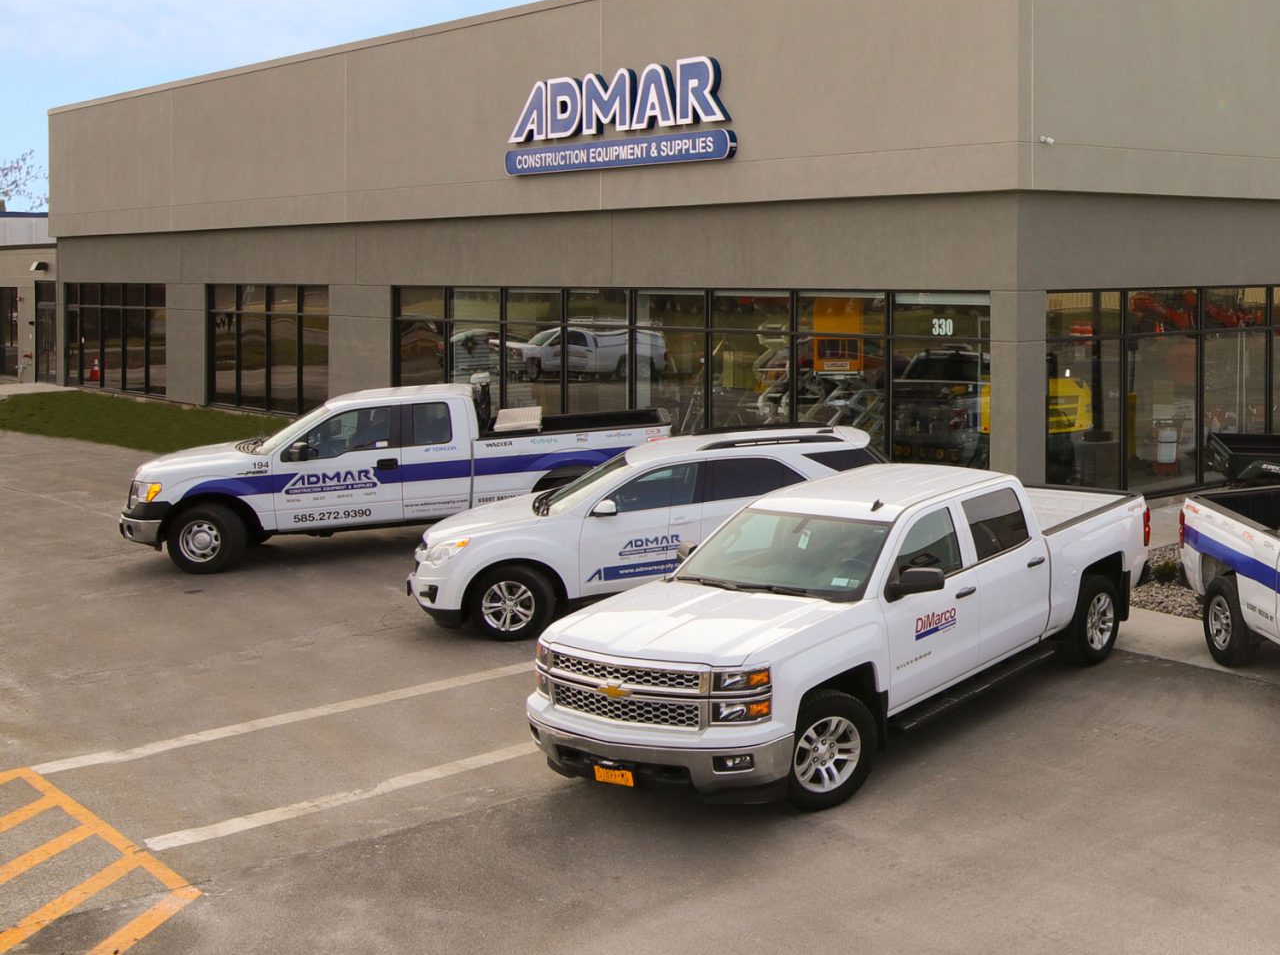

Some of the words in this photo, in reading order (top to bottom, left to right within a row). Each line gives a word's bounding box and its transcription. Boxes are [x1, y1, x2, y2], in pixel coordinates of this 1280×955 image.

[508, 56, 724, 142] ADMAR
[516, 148, 587, 169] CONSTRUCTION
[589, 143, 648, 162] EQUIPMENT
[650, 142, 658, 156] &
[660, 136, 714, 156] SUPPLIES
[932, 318, 953, 336] 330
[252, 461, 269, 470] 194
[290, 469, 373, 487] ADMAR
[293, 508, 372, 523] 585.272.9390
[623, 534, 681, 549] ADMAR
[915, 607, 956, 634] DiMarco
